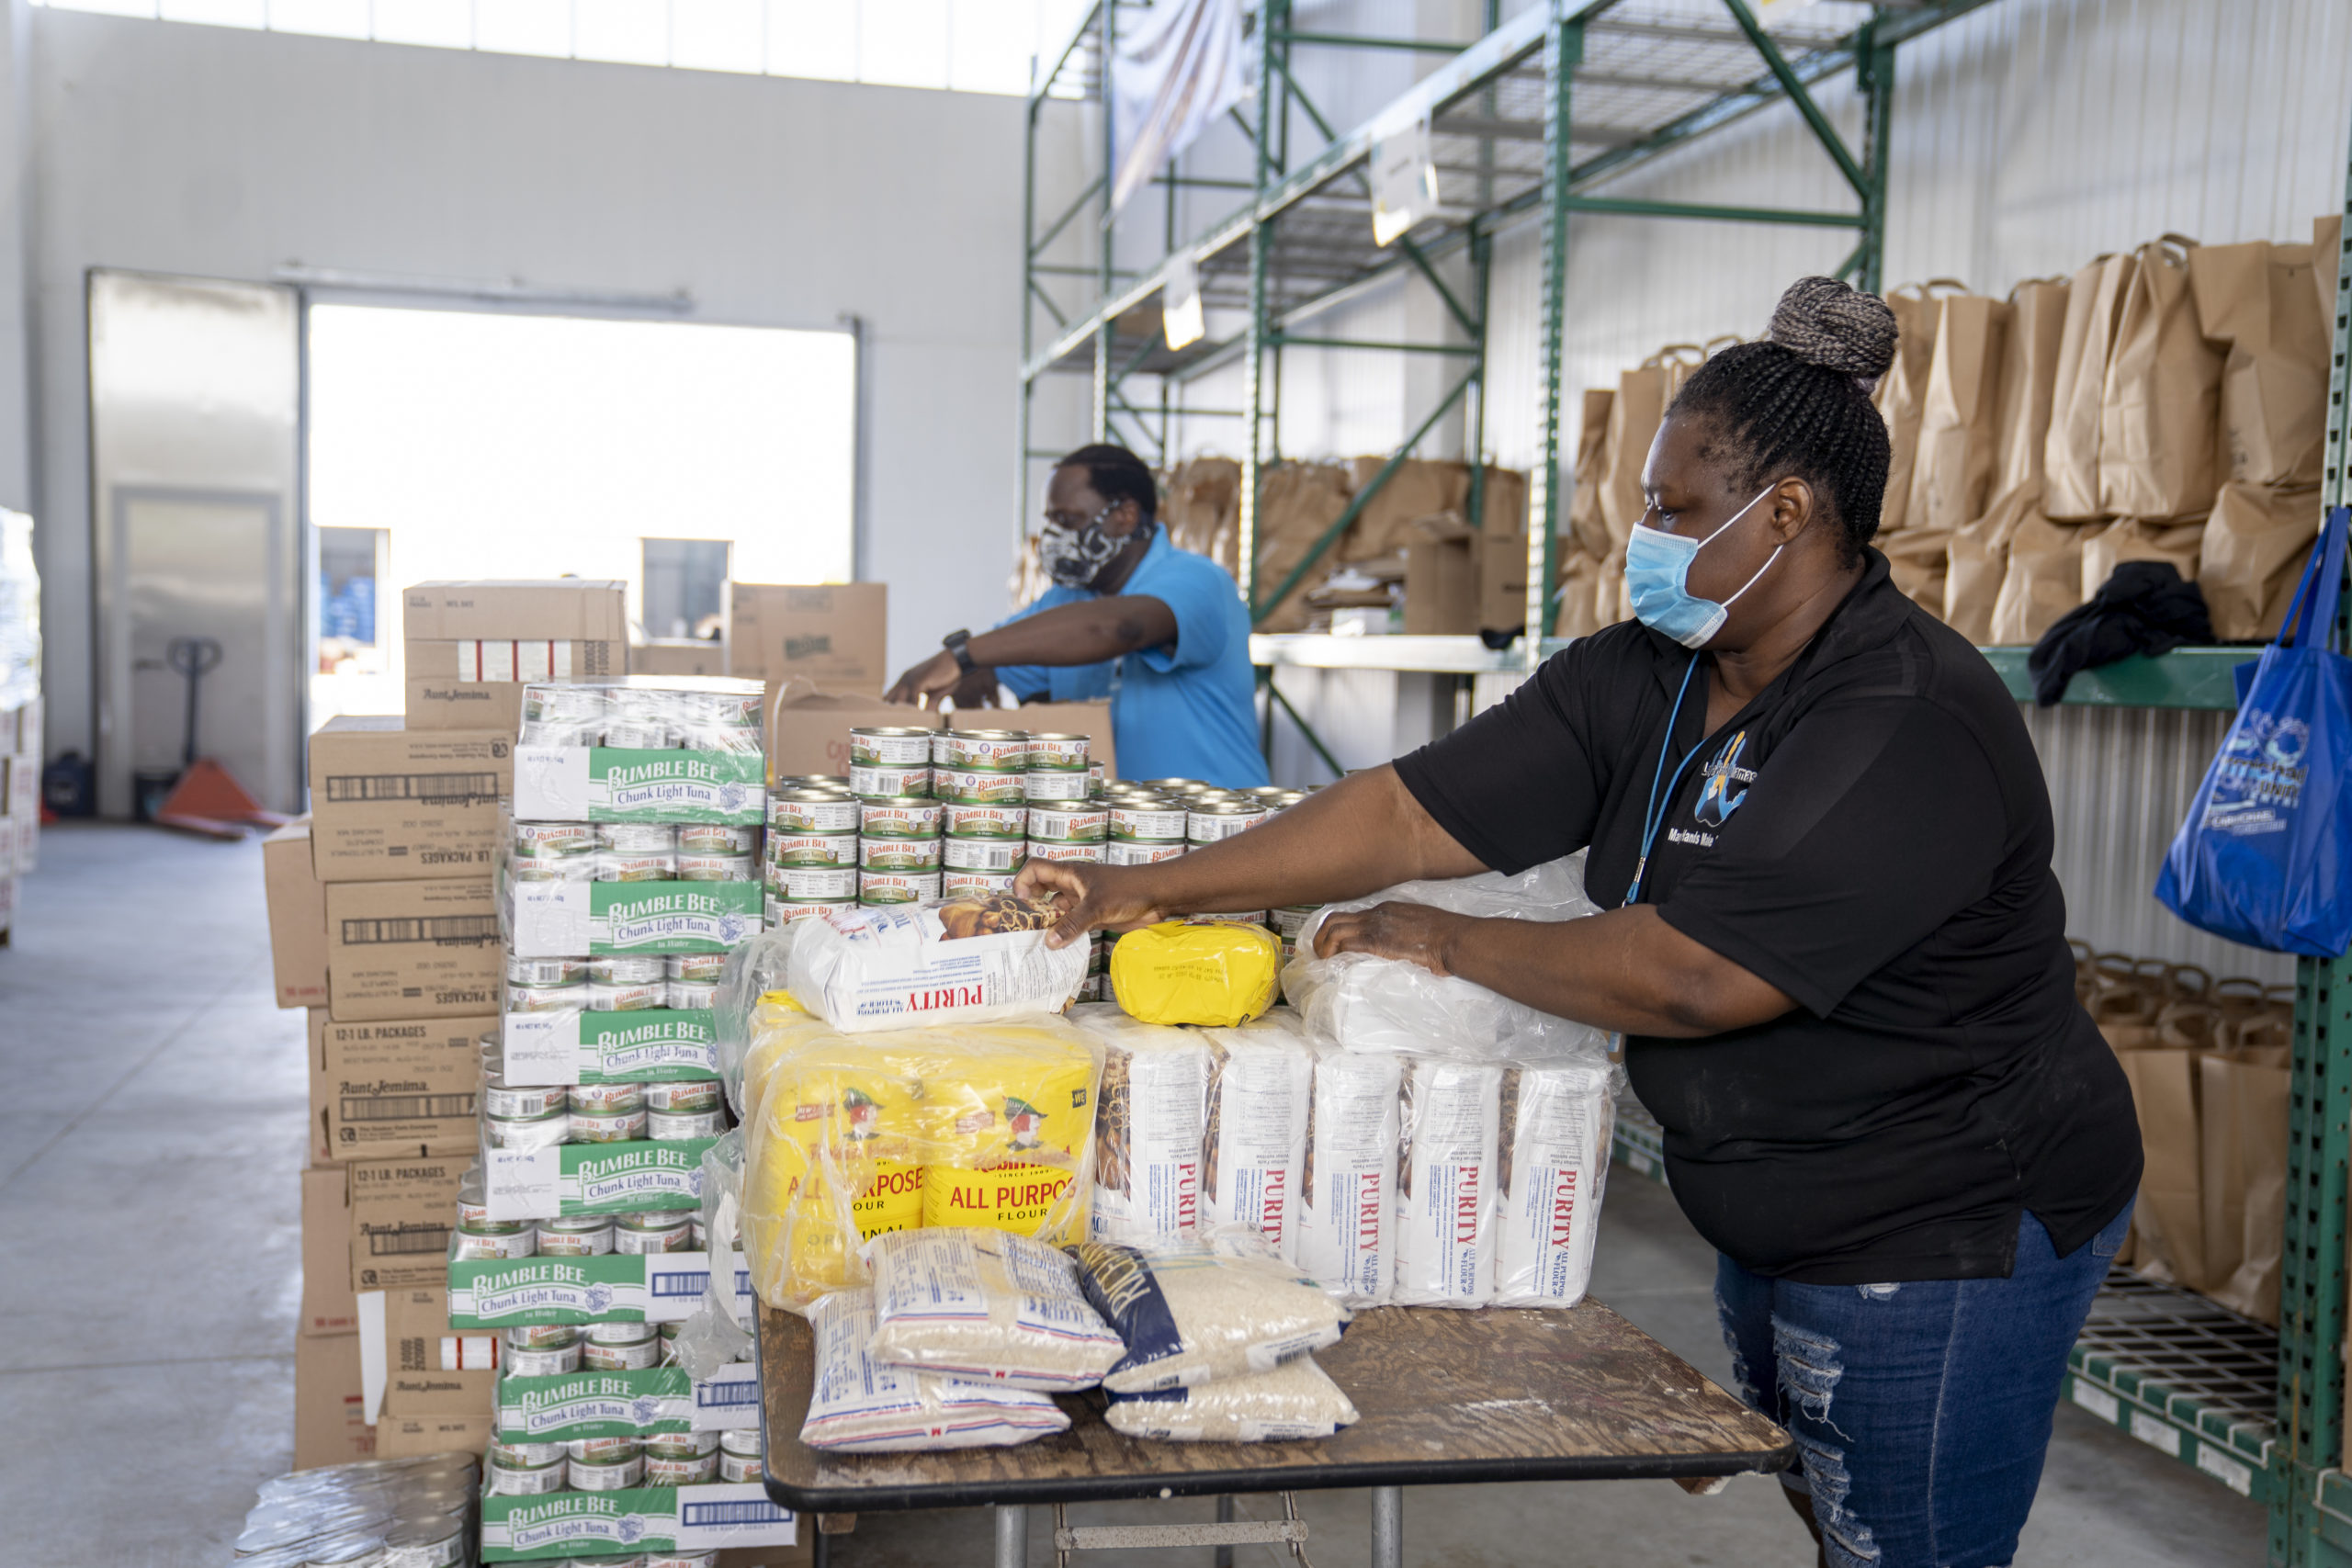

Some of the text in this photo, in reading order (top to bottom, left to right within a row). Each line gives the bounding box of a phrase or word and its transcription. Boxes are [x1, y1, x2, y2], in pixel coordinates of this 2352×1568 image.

[607, 759, 718, 792] BUMBLE BEE
[978, 778, 1012, 793] BUMBLE
[617, 786, 711, 805] Chunk Light Tuna
[789, 804, 802, 814] BEE
[864, 810, 909, 823] BUMBLE BEE
[955, 810, 1004, 824] BUMBLE BEE
[780, 839, 827, 853] BUMBLE BEE
[868, 844, 917, 858] BUMBLE BEE
[1047, 848, 1096, 861] BUMBLE BEE
[421, 851, 472, 863] PACKAGES
[863, 877, 907, 889] BUMBLE BEE
[946, 876, 990, 889] BUMBLE BEE
[608, 893, 718, 928] BUMBLE BEE
[784, 907, 817, 919] BUMBLE
[618, 919, 710, 940] Chunk Light Tuna
[435, 991, 486, 1004] PACKAGES
[906, 985, 984, 1012] PURITY
[335, 1026, 426, 1042] 12-1 LB. PACKAGES
[598, 1021, 673, 1056] BUMBLE
[676, 1021, 707, 1040] BEE
[606, 1045, 698, 1067] Chunk Light Tuna
[339, 1081, 371, 1095] Aunt
[1073, 1091, 1086, 1104] WE
[357, 1167, 447, 1182] 12-1 LB. PACKAGES
[578, 1148, 687, 1186] BUMBLE BEE
[589, 1173, 681, 1198] Chunk Light Tuna
[950, 1175, 1076, 1209] ALL PURPOS
[464, 1205, 486, 1220] BUMB
[853, 1201, 885, 1212] OUR
[998, 1209, 1048, 1221] FLOUR
[1360, 1172, 1380, 1252] PURITY
[1457, 1165, 1478, 1246] PURITY
[1552, 1168, 1577, 1249] PURITY
[472, 1265, 550, 1301] BUMBLE
[554, 1263, 585, 1282] BEE
[1460, 1260, 1468, 1283] FLOUR
[1467, 1262, 1476, 1296] PURPOSE
[1552, 1262, 1561, 1287] FLOUR
[1557, 1251, 1569, 1299] ALL PURPOSE
[481, 1290, 577, 1312] Chunk Light Tuna
[521, 1378, 632, 1416] BUMBLE BEE
[531, 1403, 625, 1428] Chunk Light Tuna
[507, 1495, 619, 1534] BUMBLE BEE
[516, 1520, 610, 1545] Chunk Light Tuna
